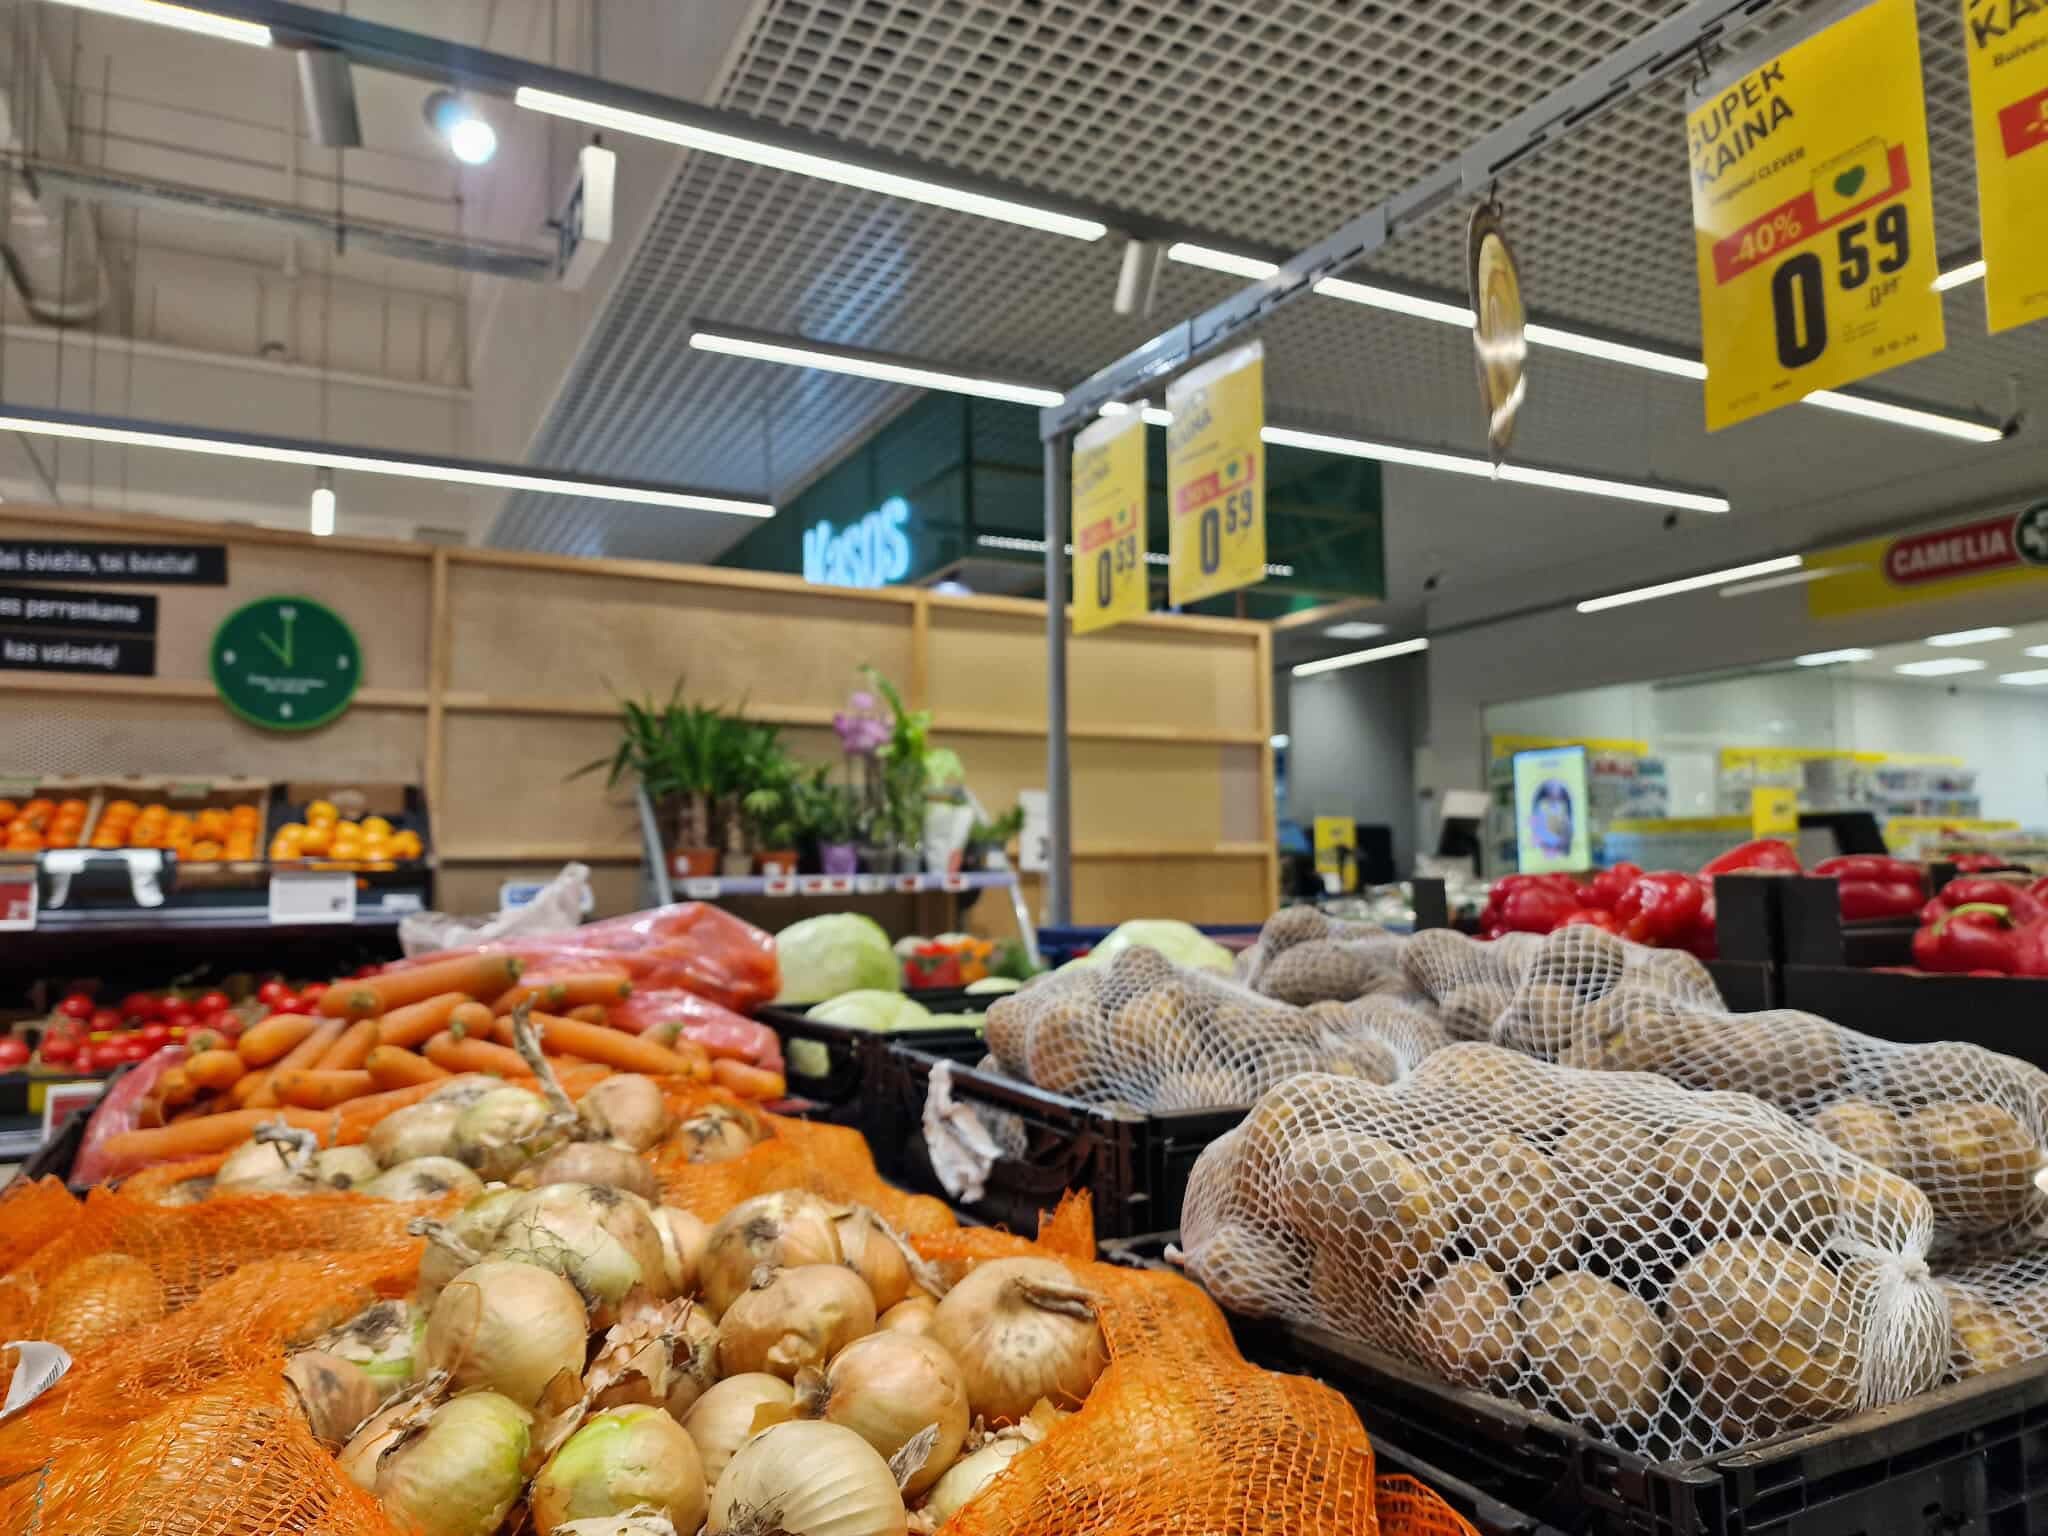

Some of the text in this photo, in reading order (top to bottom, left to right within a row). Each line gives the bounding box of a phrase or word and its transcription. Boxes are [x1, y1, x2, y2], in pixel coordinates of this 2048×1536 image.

[1969, 0, 2048, 48] KA
[1697, 95, 1794, 190] KAINA
[1730, 207, 1802, 265] -40%
[1772, 203, 1910, 371] 0 59
[1892, 529, 2008, 576] CAMELIA
